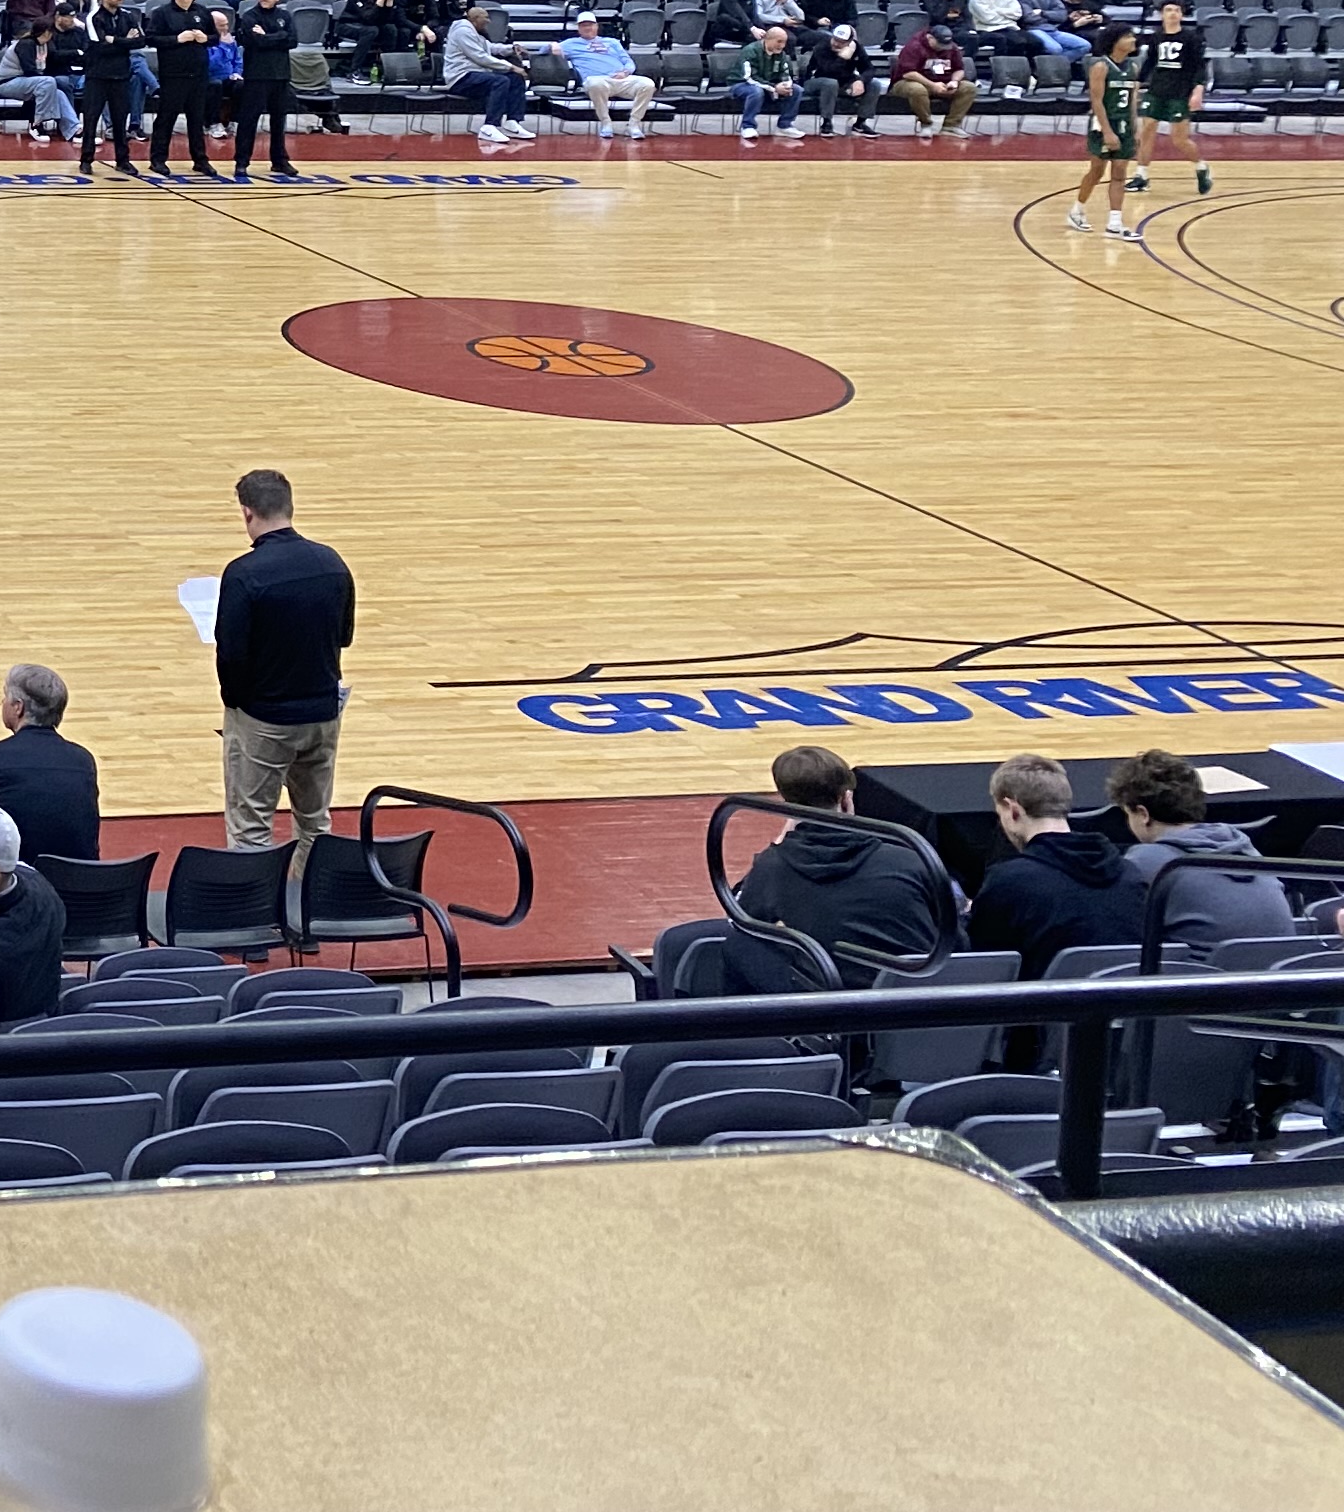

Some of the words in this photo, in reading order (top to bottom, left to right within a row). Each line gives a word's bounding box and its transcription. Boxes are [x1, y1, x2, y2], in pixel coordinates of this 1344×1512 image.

[1117, 90, 1129, 108] 3
[349, 173, 581, 186] GRAND
[517, 682, 974, 735] GRAND
[957, 670, 1344, 721] RIVER
